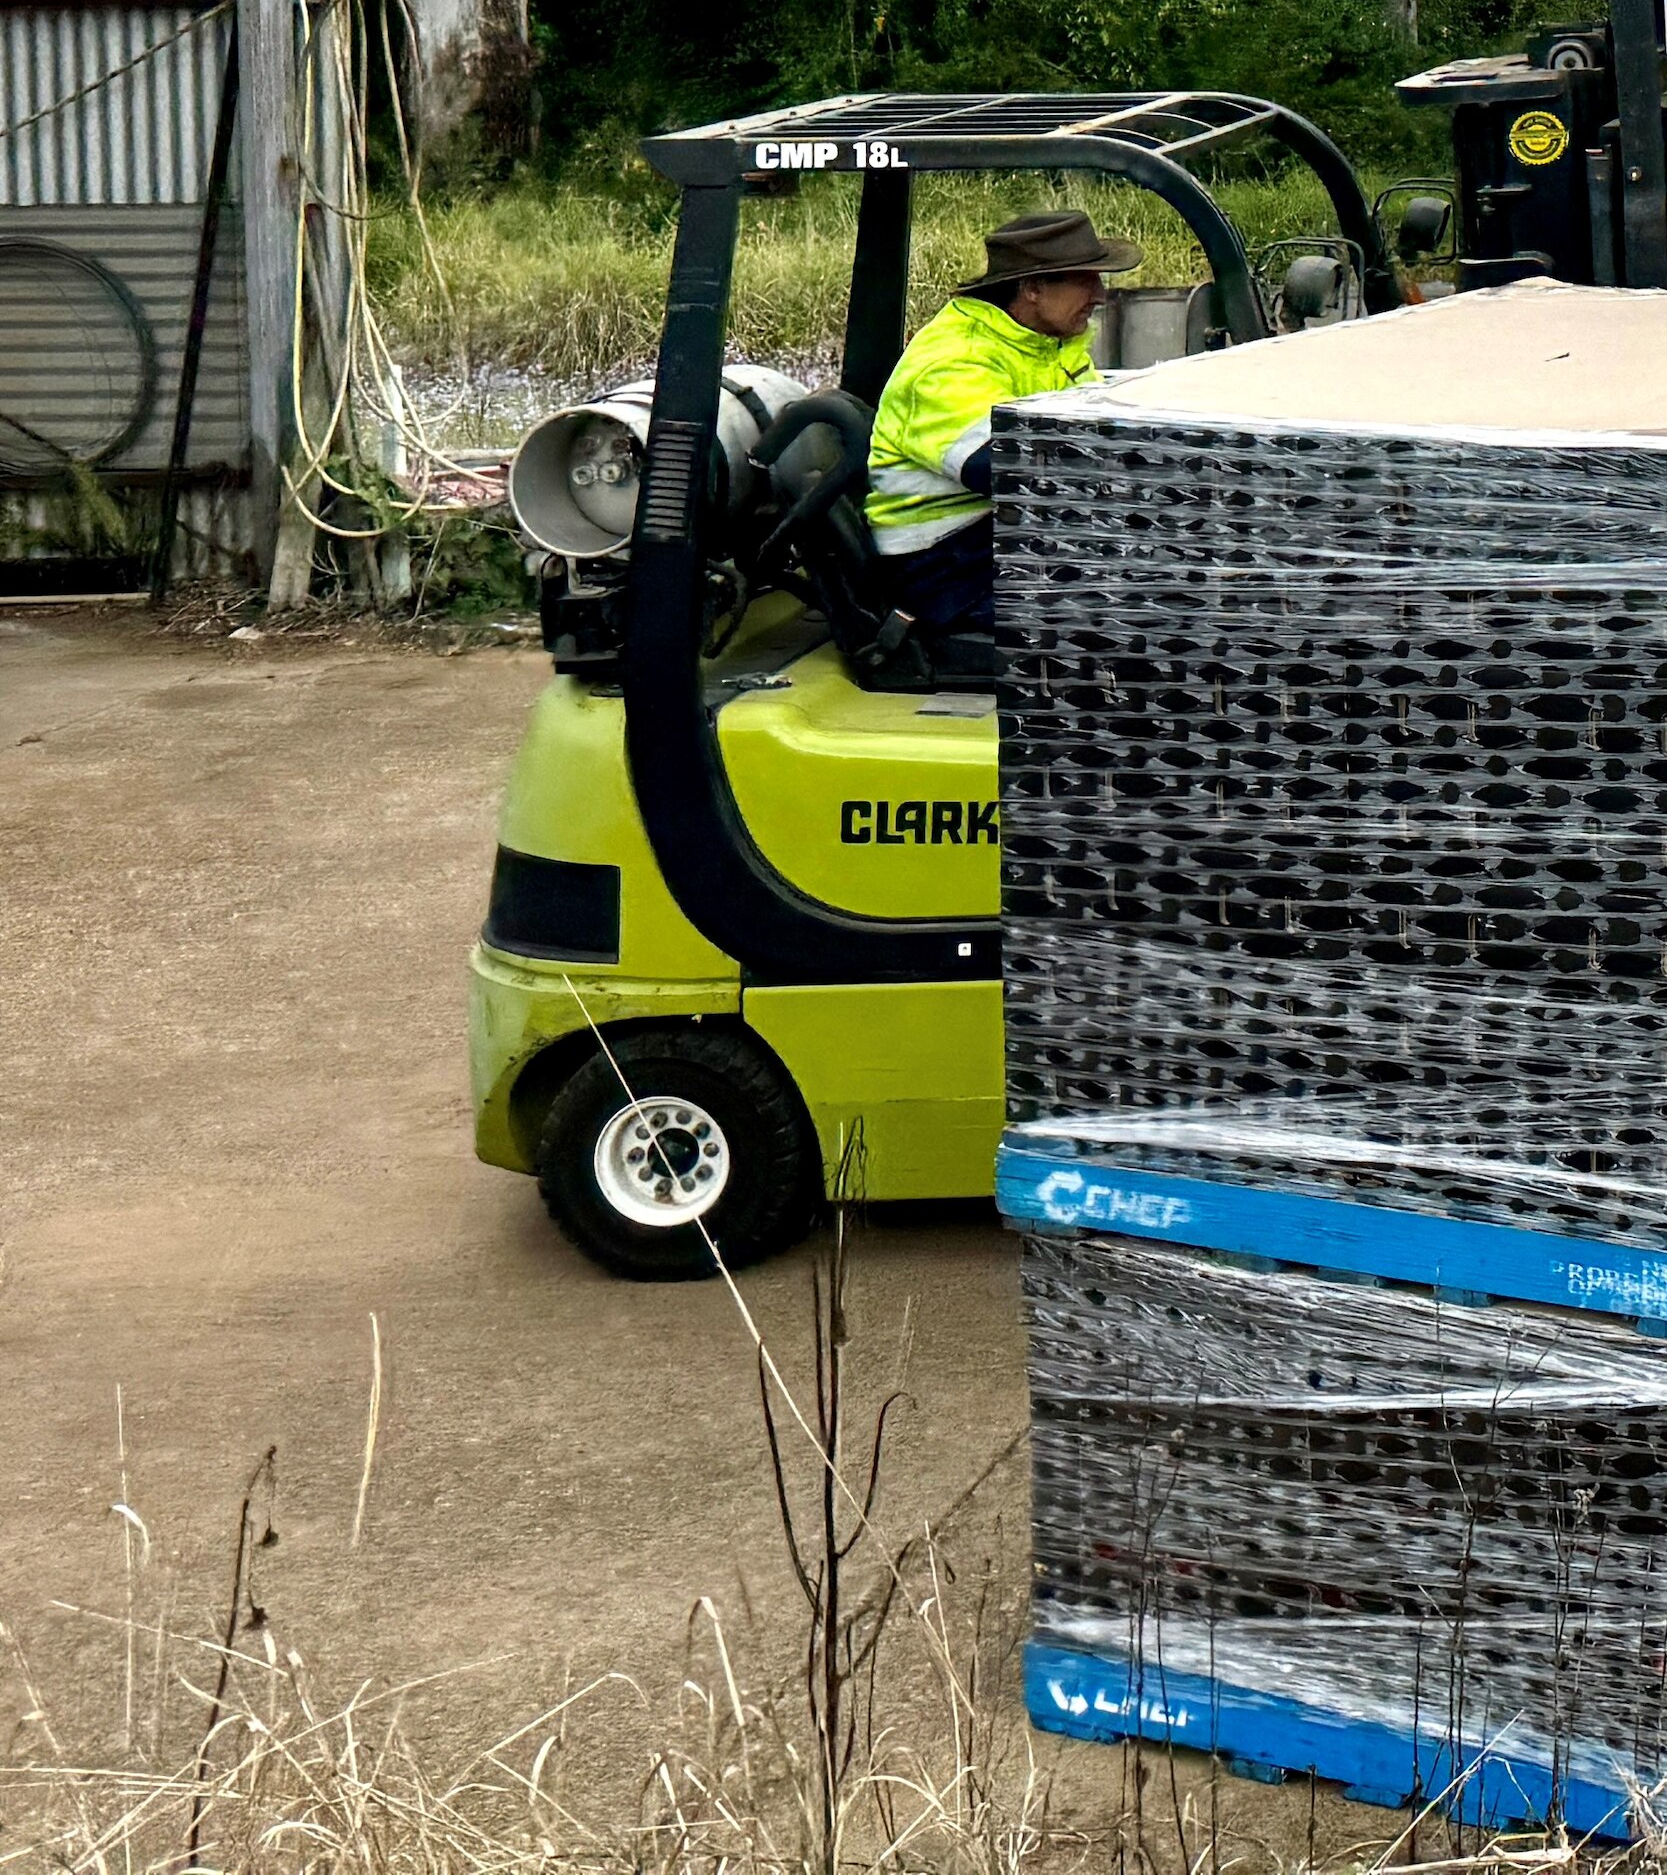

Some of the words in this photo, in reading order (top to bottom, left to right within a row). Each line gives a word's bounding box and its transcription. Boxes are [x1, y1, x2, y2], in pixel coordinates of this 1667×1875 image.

[755, 142, 839, 169] CMP
[853, 141, 909, 168] 18L
[841, 800, 1000, 844] CLARK
